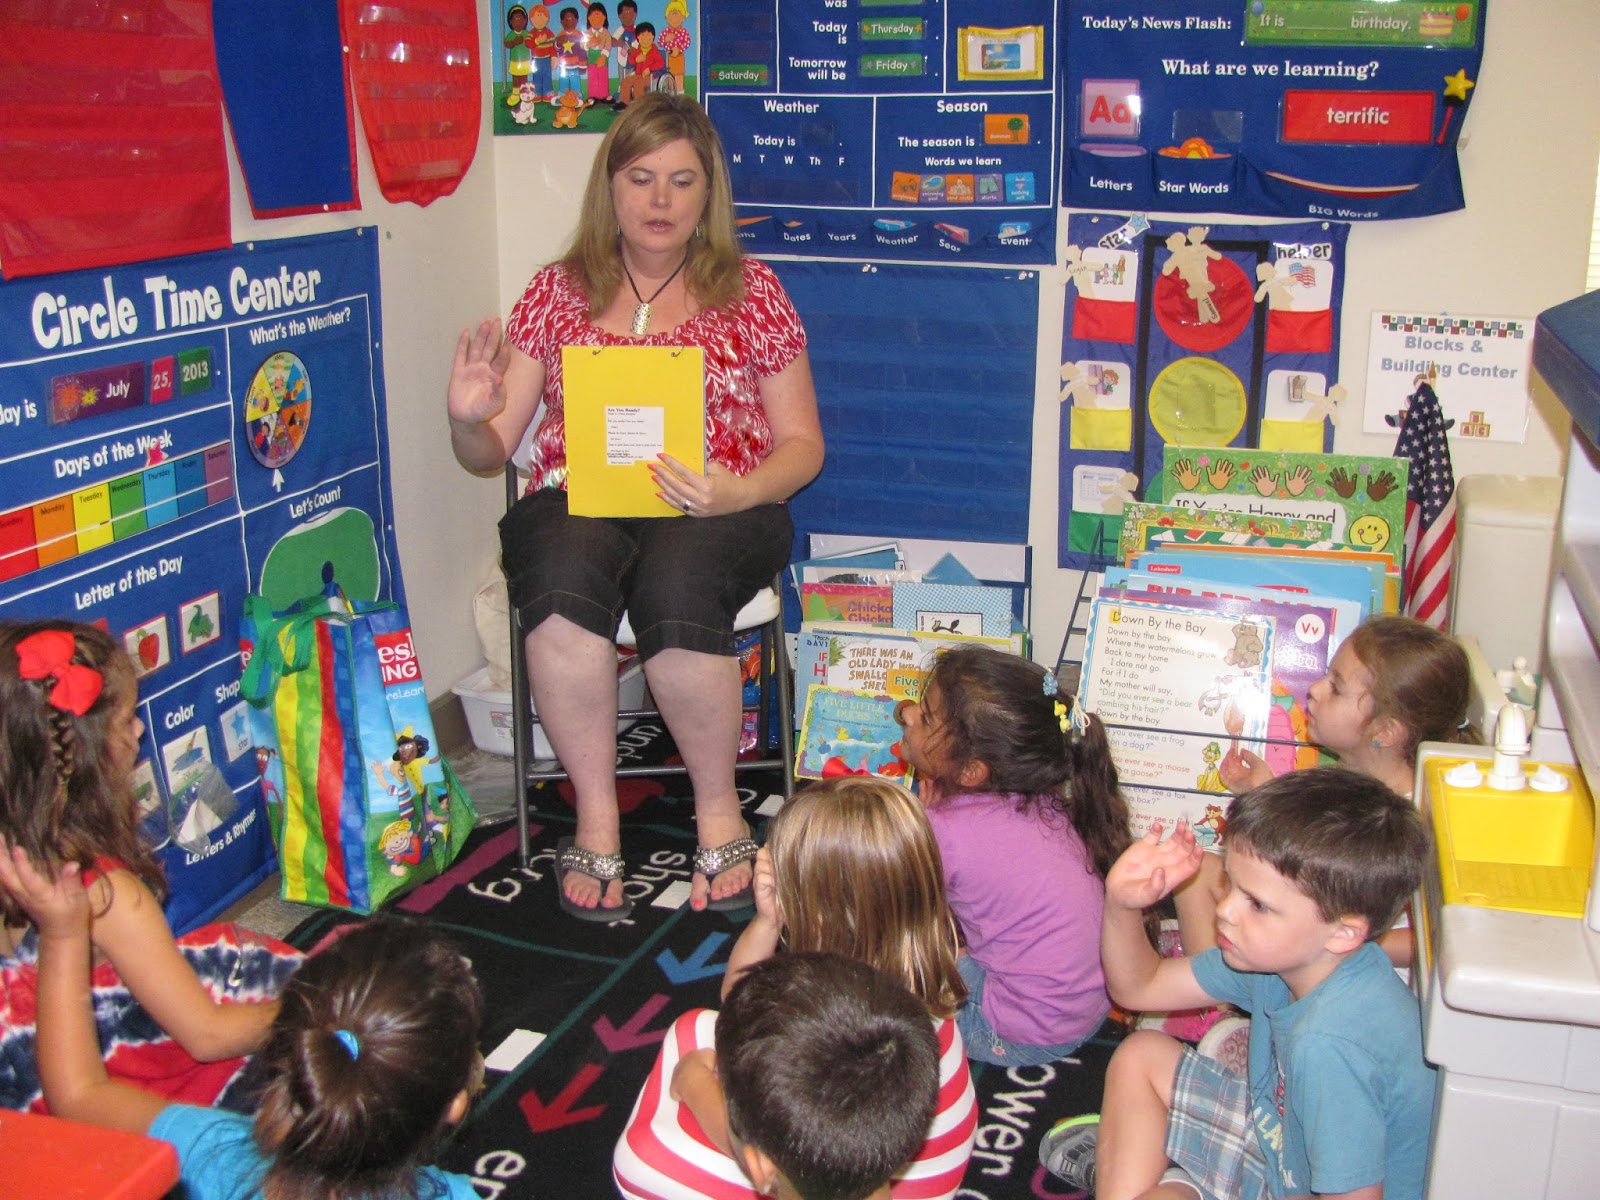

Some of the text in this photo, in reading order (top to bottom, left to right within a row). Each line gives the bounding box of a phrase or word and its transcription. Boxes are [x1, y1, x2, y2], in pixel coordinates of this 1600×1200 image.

[813, 20, 847, 35] Today
[870, 20, 914, 36] Thursday
[1082, 16, 1232, 31] Today's News Flash:
[1259, 15, 1412, 33] It is birthday.
[838, 34, 847, 45] is
[789, 56, 847, 69] Tomorrow
[876, 60, 908, 72] Friday
[1162, 59, 1380, 81] What are we learning?
[718, 70, 759, 82] Saturday
[808, 69, 846, 81] will be
[763, 99, 820, 114] Weather
[936, 99, 988, 113] Season
[1089, 95, 1131, 124] Aa
[1326, 107, 1390, 125] terrific
[753, 134, 796, 148] Today is
[898, 135, 975, 147] The season is
[733, 153, 845, 166] M T W Th F
[924, 156, 1002, 166] Words we learn
[1089, 176, 1133, 191] Letters
[1159, 180, 1229, 194] Star Words
[1308, 204, 1379, 219] BIG Words
[783, 232, 919, 245] Dates Years Weather
[1277, 243, 1331, 259] heer
[32, 266, 322, 349] Circle Time Center
[250, 306, 351, 346] What's the Weather?
[1404, 335, 1483, 353] Blocks &
[182, 359, 210, 382] 2013
[1457, 362, 1518, 379] Center
[105, 379, 131, 398] July
[154, 372, 172, 390] 25,
[24, 399, 38, 419] is
[54, 454, 91, 479] Days
[93, 446, 109, 465] of
[112, 441, 135, 462] the
[147, 469, 171, 481] Thursday
[111, 478, 142, 493] Wednesday
[79, 491, 103, 504] Tuesday
[289, 485, 342, 519] Let's Count
[40, 503, 65, 517] Monday
[75, 555, 183, 611] Letter of the Day
[1112, 610, 1207, 637] Down By the Bay
[1107, 626, 1172, 643] Down by the bay
[850, 647, 913, 660] THERE WAS AN
[1106, 637, 1195, 656] Where the watermelons
[1104, 647, 1169, 663] Back to my home
[848, 659, 896, 672] OLD LADY
[1115, 658, 1162, 673] dare not go.
[894, 676, 919, 687] Five
[1102, 668, 1139, 680] For if do
[215, 679, 240, 704] Shap
[1099, 678, 1173, 696] My mother will say,
[825, 697, 885, 713] FIVE LITTLE
[1097, 699, 1129, 712] combing
[1131, 701, 1143, 711] his
[1117, 691, 1132, 701] you
[1134, 693, 1150, 702] ever
[1151, 695, 1165, 704] see
[1174, 697, 1193, 708] bear
[165, 703, 195, 730] Color
[1095, 708, 1161, 726] Down by the bay
[1112, 729, 1126, 738] you
[1146, 733, 1159, 741] see
[1169, 735, 1185, 746] frog
[1165, 764, 1190, 773] moose
[225, 828, 233, 845] &
